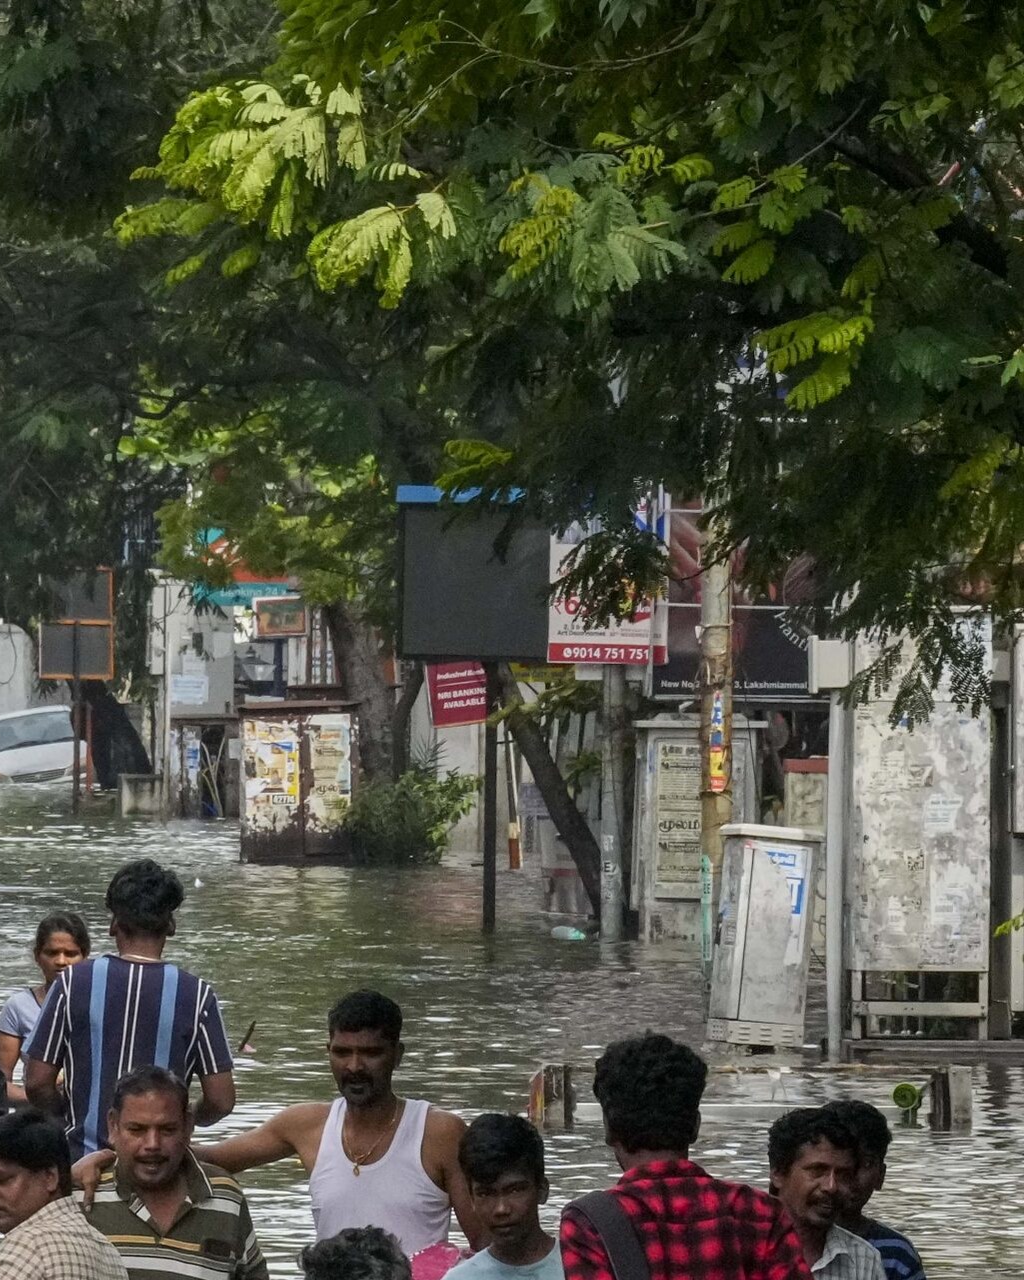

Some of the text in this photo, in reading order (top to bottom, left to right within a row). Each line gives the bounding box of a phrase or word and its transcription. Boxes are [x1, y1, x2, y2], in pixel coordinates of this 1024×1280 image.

[573, 647, 649, 660] 9014 751 751
[661, 680, 679, 688] New
[437, 691, 452, 700] NRI
[443, 696, 486, 709] AVAILABLE
